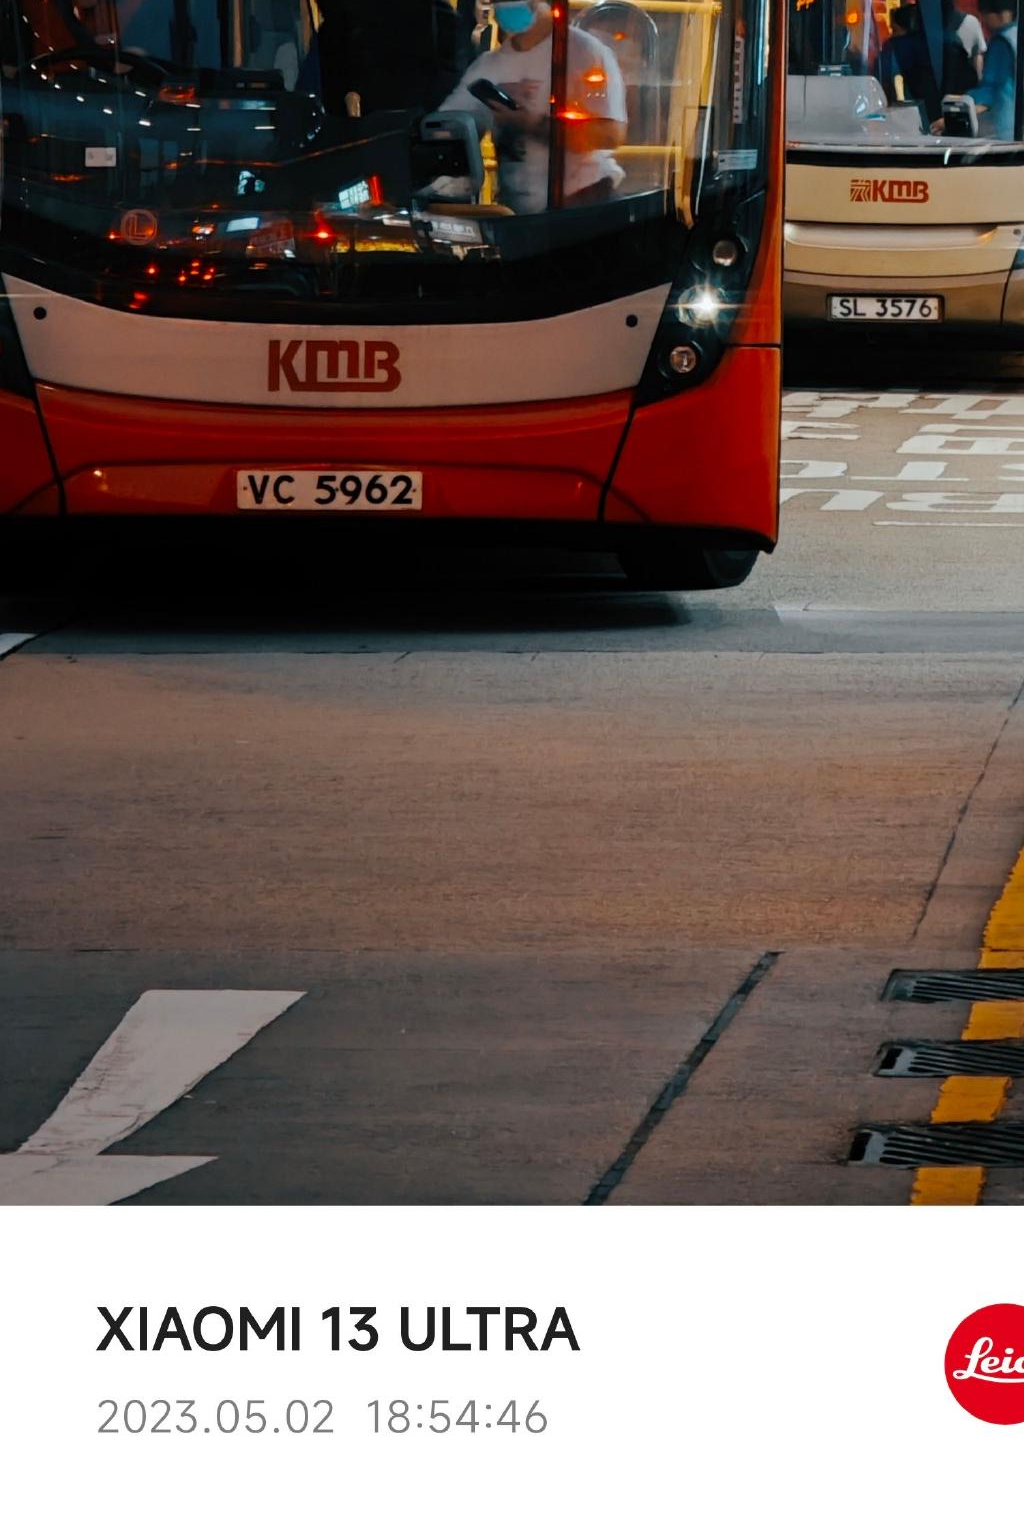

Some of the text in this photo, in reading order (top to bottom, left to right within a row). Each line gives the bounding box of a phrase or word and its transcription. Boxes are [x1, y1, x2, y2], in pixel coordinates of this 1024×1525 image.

[872, 180, 930, 203] KMB
[840, 299, 932, 318] SL 3576
[267, 340, 401, 392] KMB
[247, 475, 414, 505] VC 5962
